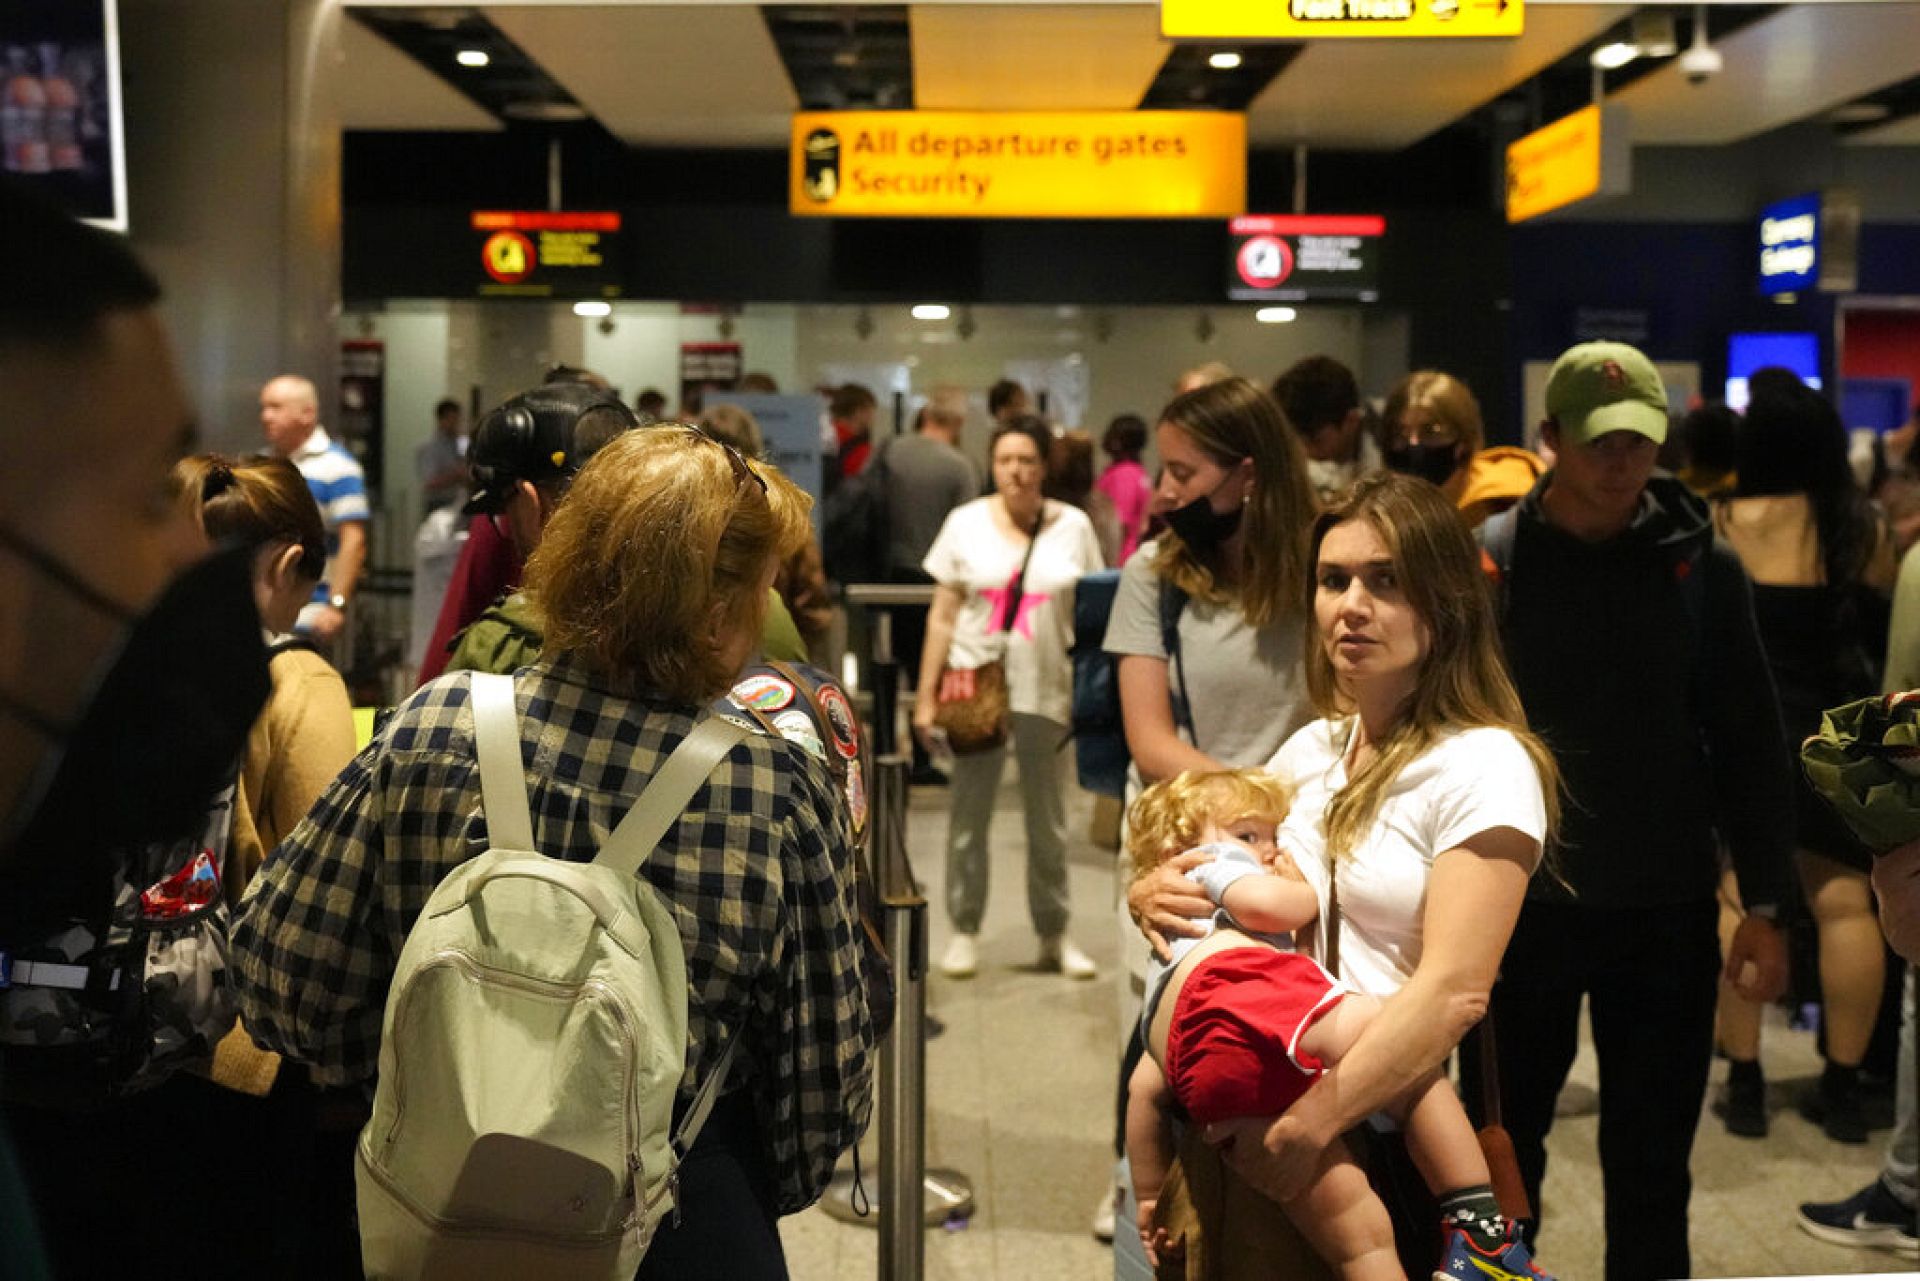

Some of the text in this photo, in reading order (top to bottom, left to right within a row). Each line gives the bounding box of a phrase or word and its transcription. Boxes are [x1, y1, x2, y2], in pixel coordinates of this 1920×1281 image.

[853, 129, 1187, 163] All departure gates
[853, 169, 991, 199] Security
